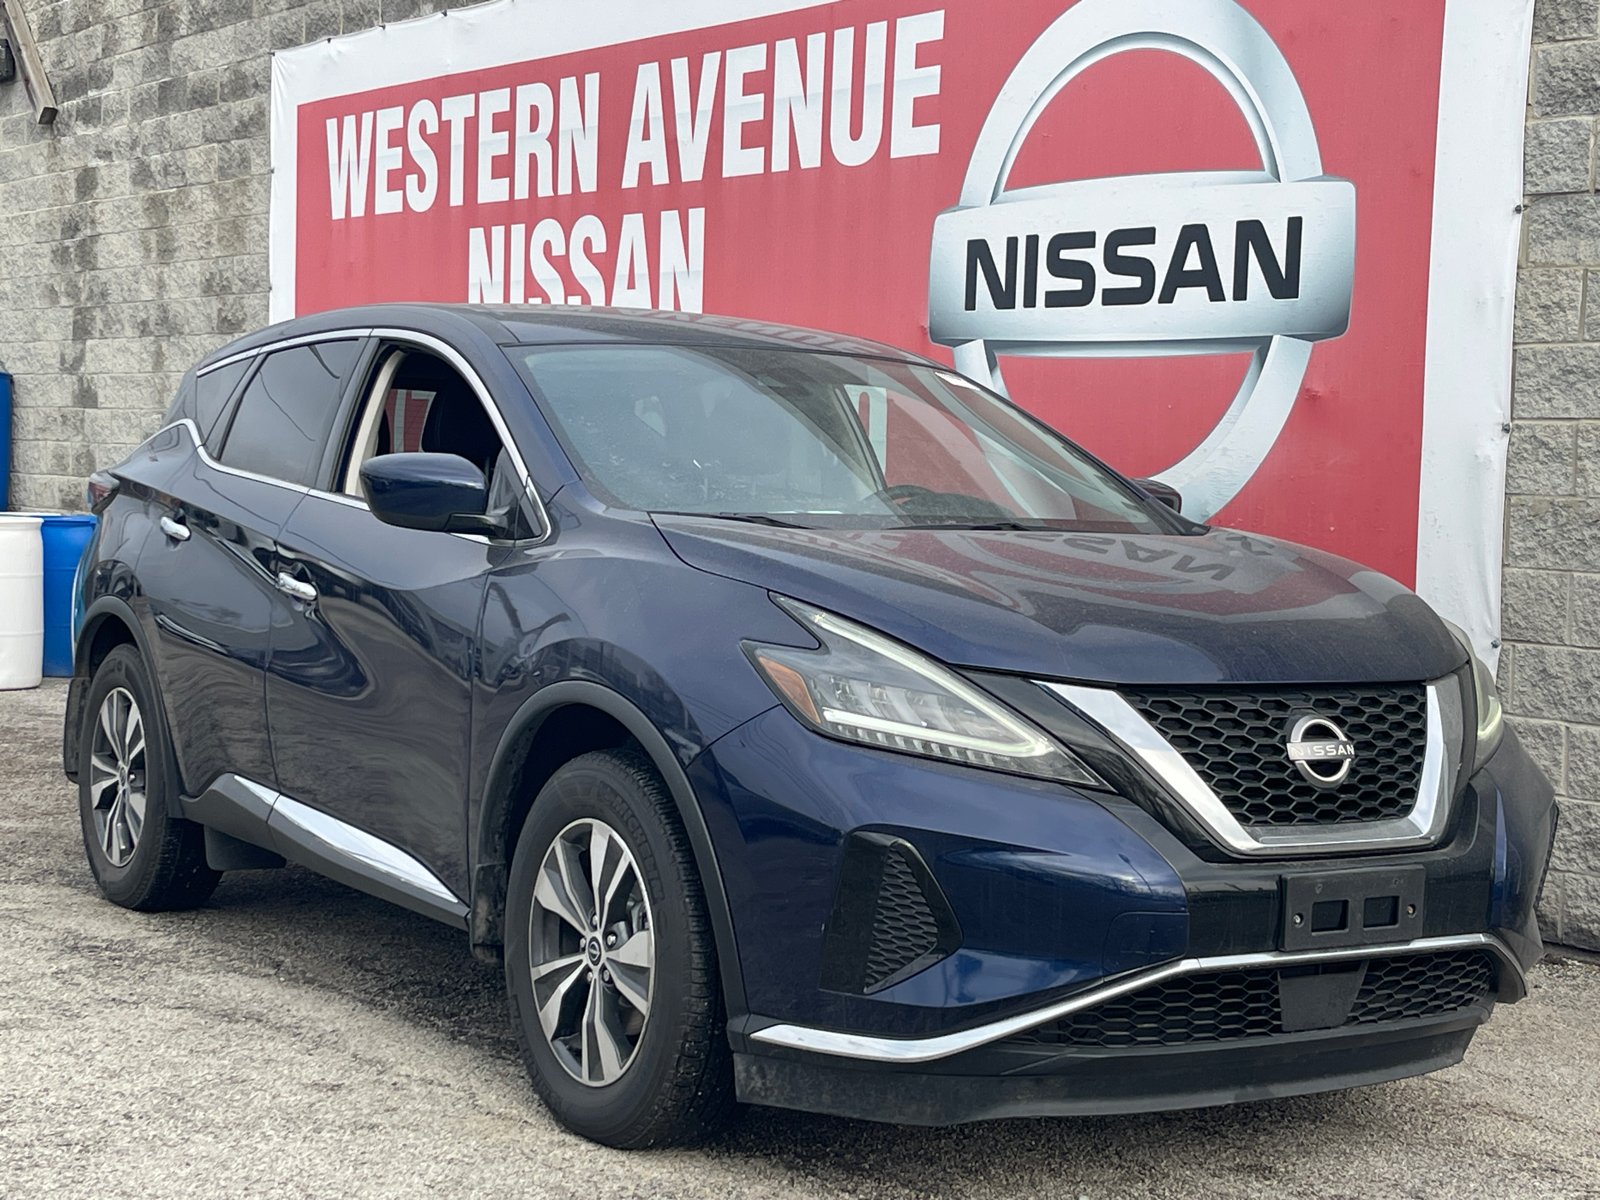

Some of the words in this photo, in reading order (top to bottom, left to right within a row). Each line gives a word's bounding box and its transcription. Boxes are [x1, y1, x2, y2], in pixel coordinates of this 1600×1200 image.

[325, 72, 600, 221] WESTERN
[621, 9, 945, 189] AVENUE
[468, 207, 705, 315] NISSAN
[964, 216, 1303, 311] NISSAN
[1289, 744, 1355, 757] NISSAN
